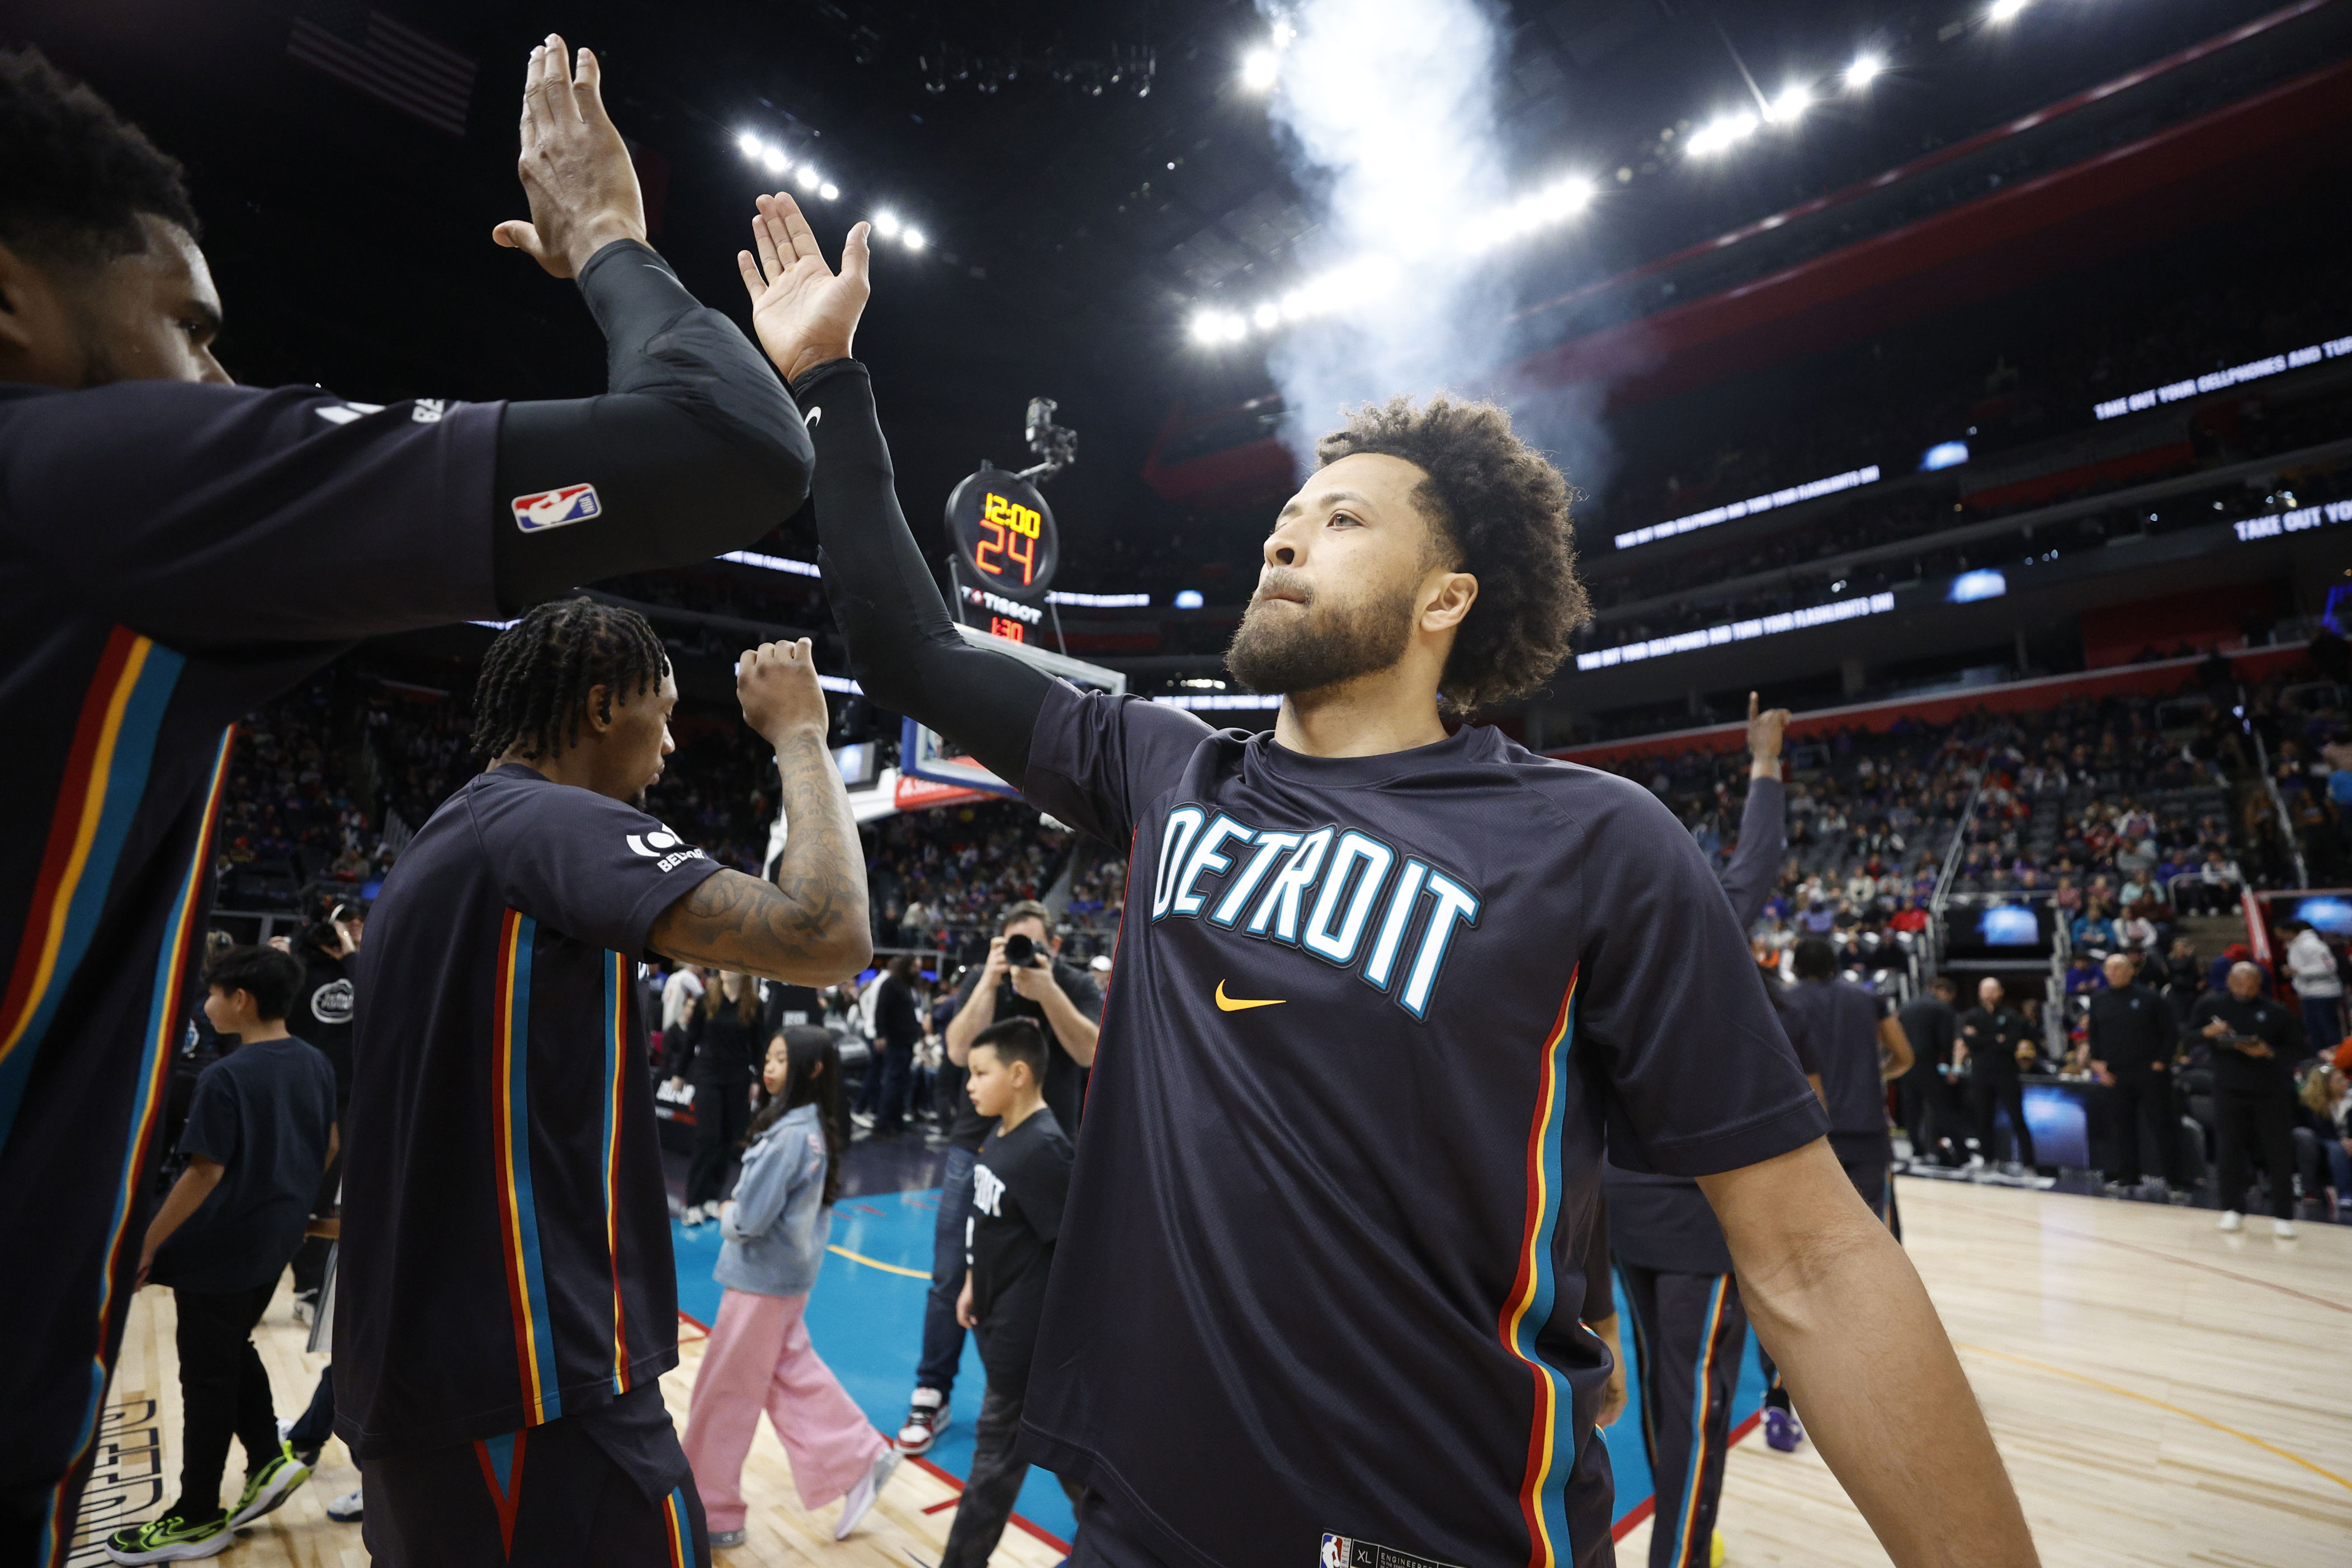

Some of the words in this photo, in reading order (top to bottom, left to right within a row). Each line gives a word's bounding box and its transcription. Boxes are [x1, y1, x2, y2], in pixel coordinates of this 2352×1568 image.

[985, 492, 1041, 539] 12:00
[2233, 514, 2283, 541] TAKE
[2282, 506, 2322, 532] OUT
[2323, 499, 2352, 523] YO
[976, 519, 1035, 585] 24
[983, 592, 1042, 625] TISSOT
[991, 616, 1024, 644] 1:30
[1151, 807, 1480, 1019] DETROIT
[1357, 1550, 1371, 1564] XL
[1381, 1552, 1432, 1568] ENGINEER
